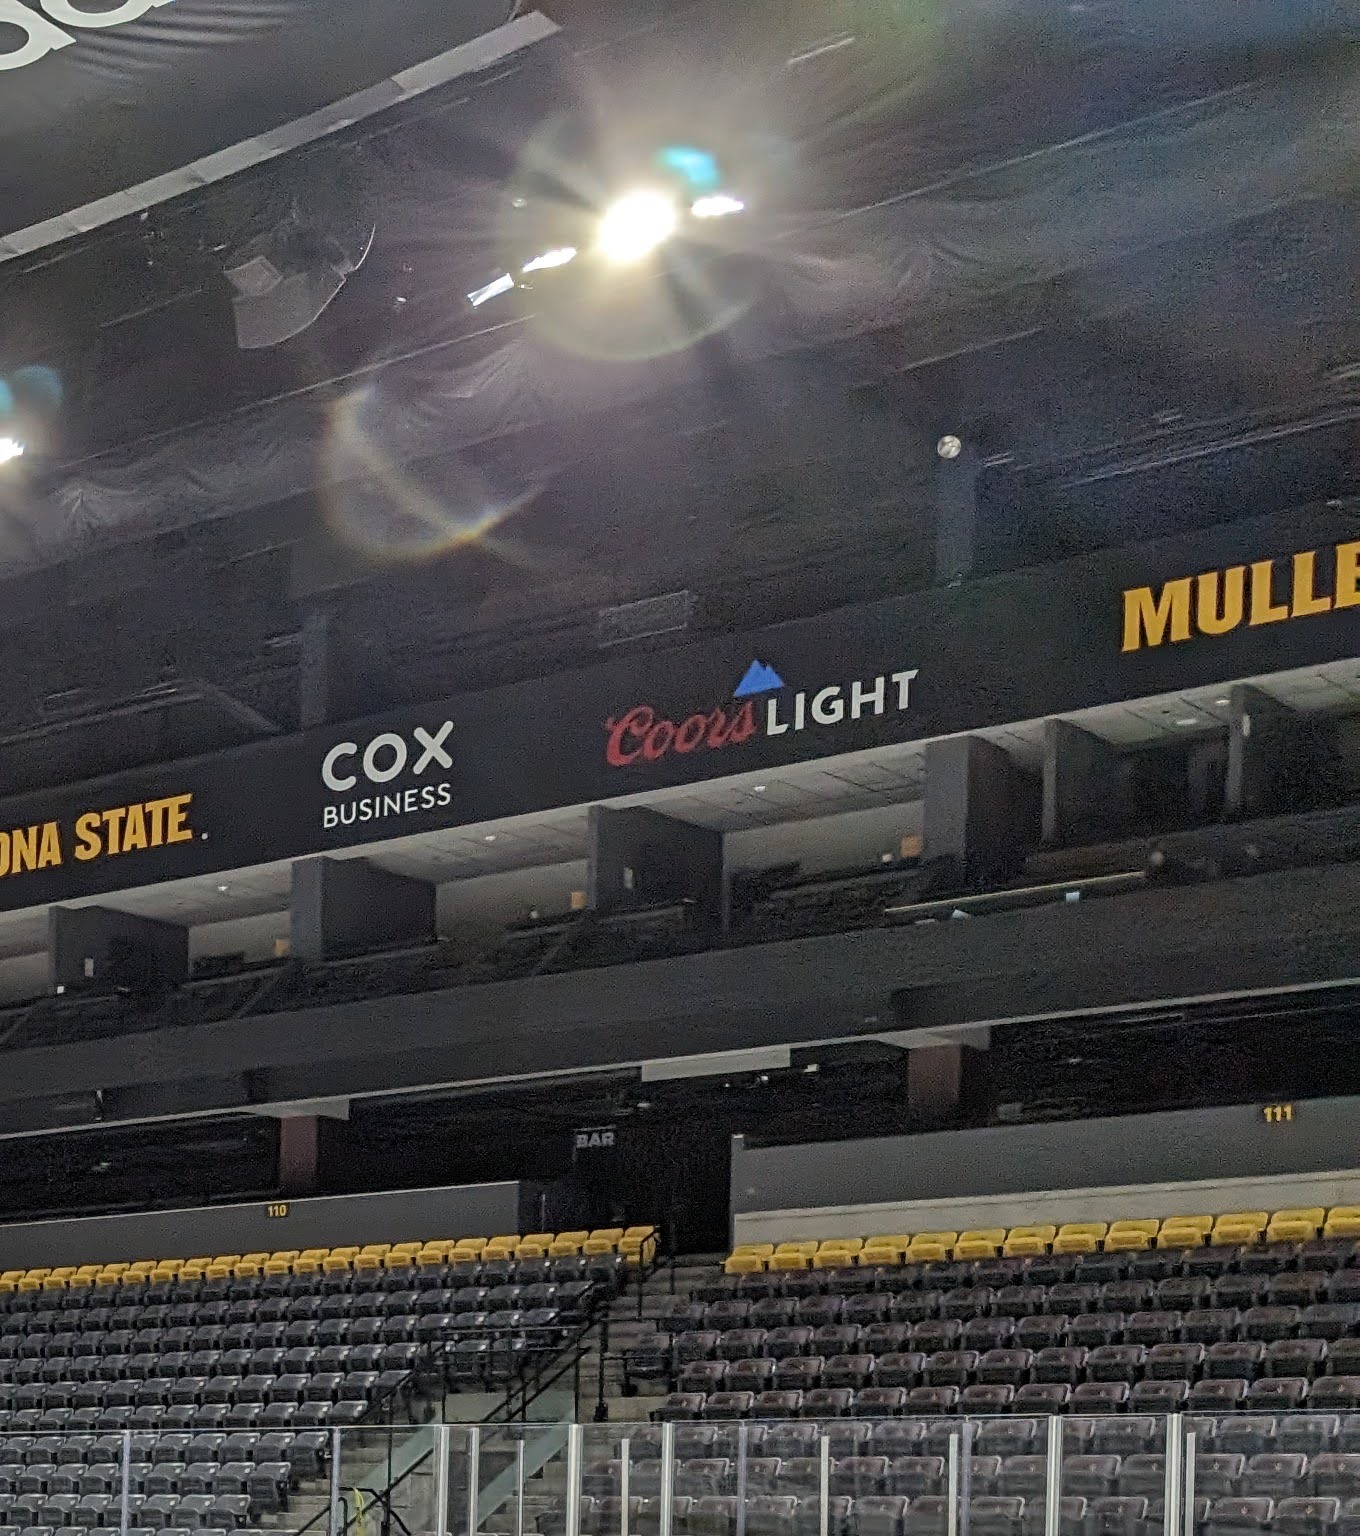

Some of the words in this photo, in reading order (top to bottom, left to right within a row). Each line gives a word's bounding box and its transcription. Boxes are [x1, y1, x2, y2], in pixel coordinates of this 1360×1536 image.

[606, 699, 757, 767] Coors
[766, 669, 919, 736] LIGHT
[321, 720, 455, 793] COX
[73, 793, 195, 862] STATE
[322, 783, 452, 829] BUSINESS
[1263, 1105, 1292, 1122] 111
[576, 1132, 615, 1148] BAR
[268, 1204, 287, 1217] 110
